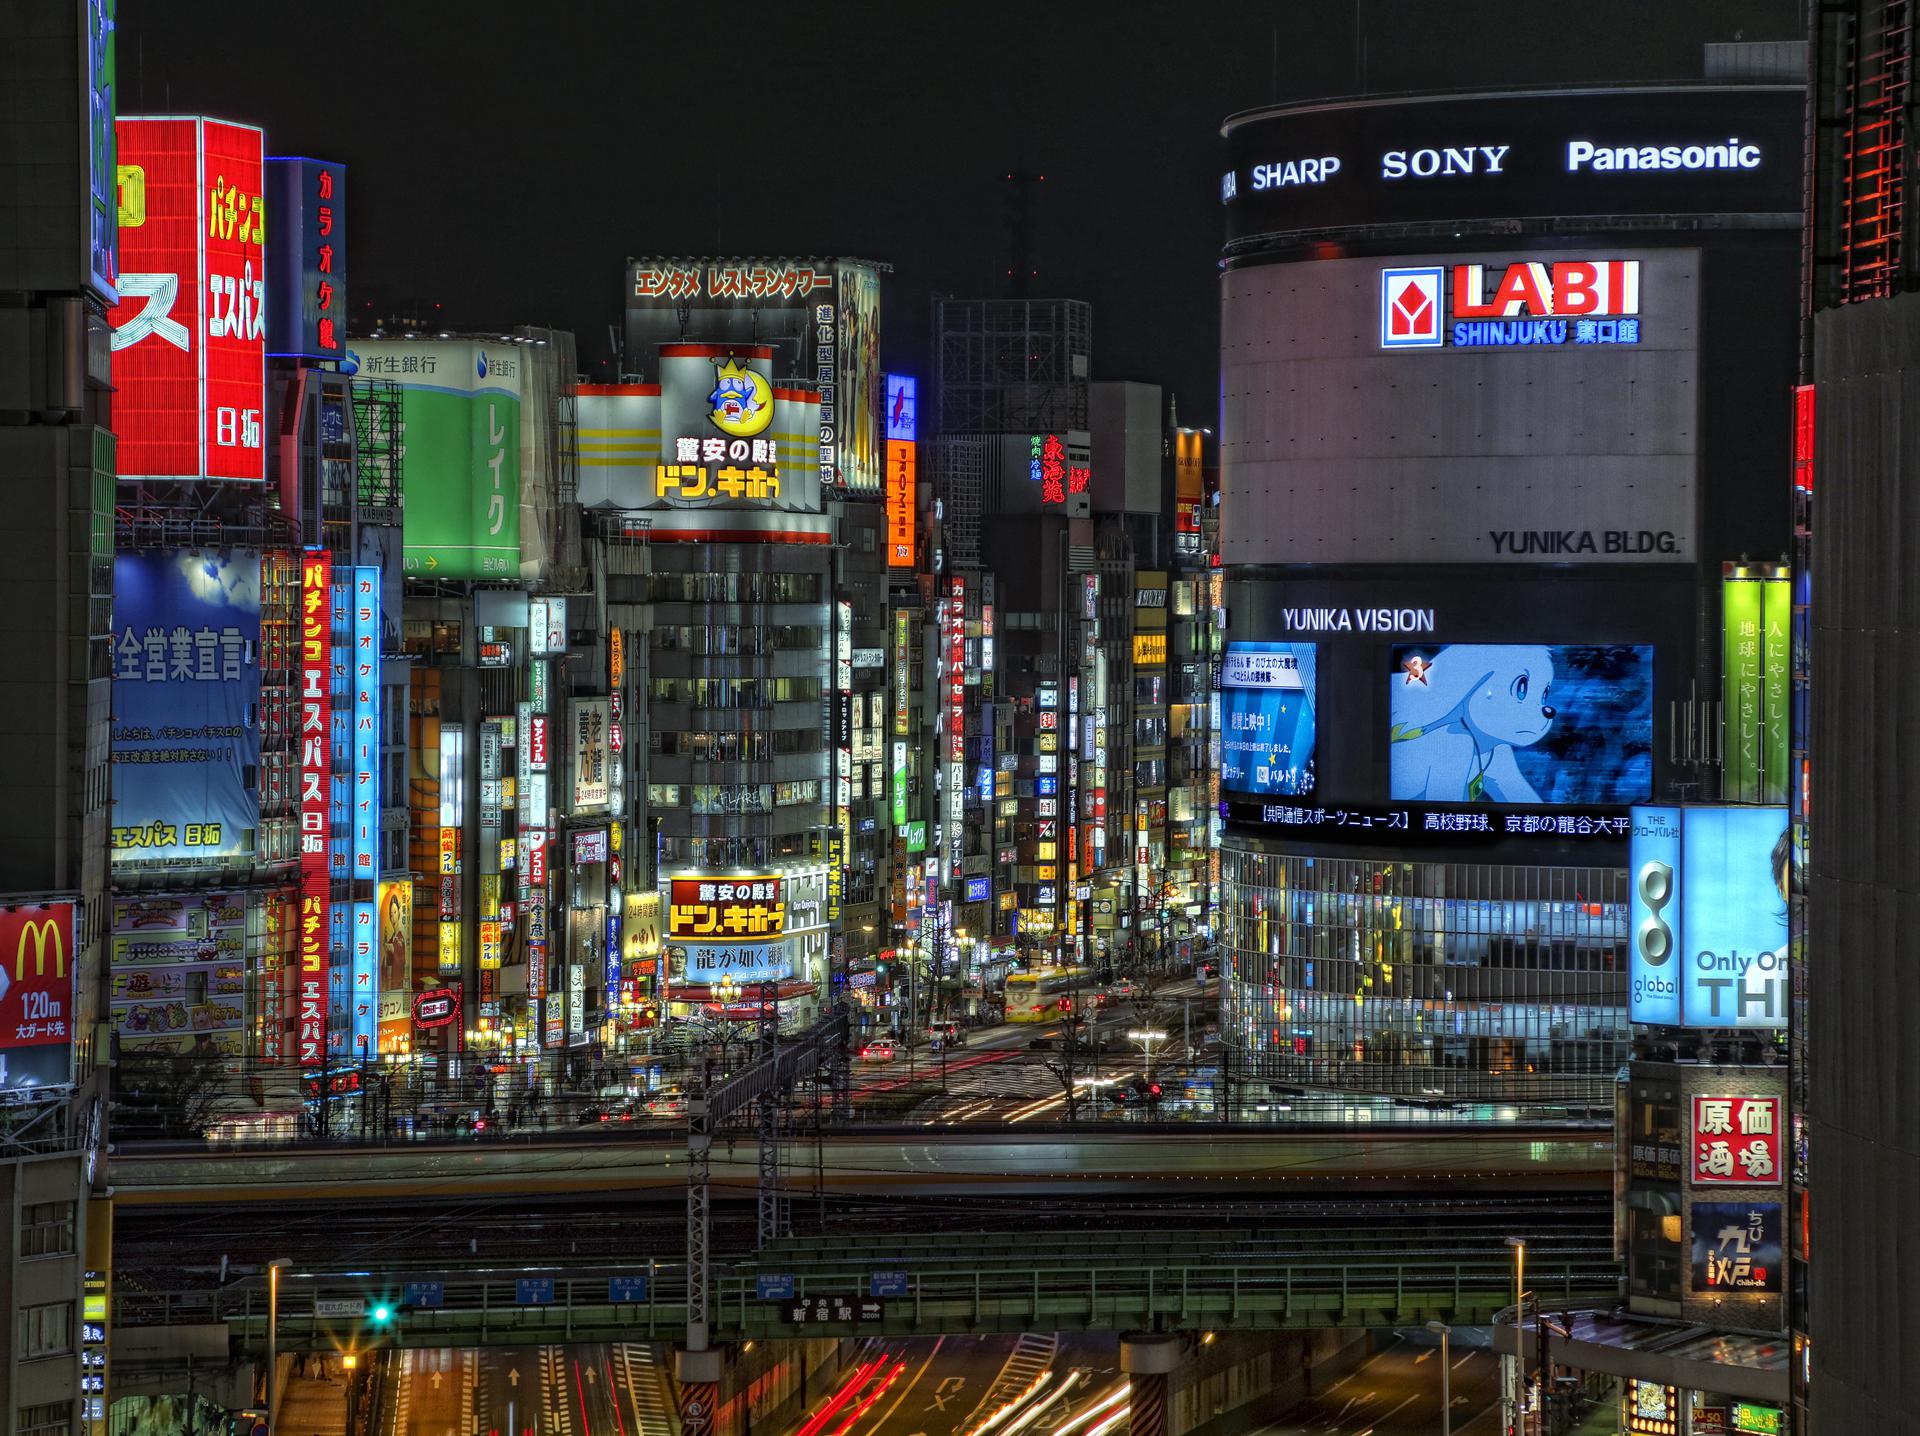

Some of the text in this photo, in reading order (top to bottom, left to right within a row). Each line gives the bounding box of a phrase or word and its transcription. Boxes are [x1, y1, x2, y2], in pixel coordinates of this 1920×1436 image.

[1253, 156, 1341, 190] SHARP
[1383, 145, 1511, 179] SONY
[1569, 137, 1762, 171] Panasonic
[209, 175, 264, 245] パチンコ
[635, 267, 832, 300] エンタメ レストランタワー
[1453, 260, 1641, 319] LABI
[209, 260, 265, 341] エスパス
[1453, 320, 1641, 346] SHINJUKU 東口館
[365, 355, 437, 374] 新生銀行
[216, 406, 261, 448] 日拓
[676, 437, 777, 464] 驚安の殿堂
[487, 403, 505, 536] レイク
[898, 447, 907, 539] PROMISE
[1490, 530, 1682, 554] YUNIKA BLDG.
[1282, 608, 1435, 632] YUNIKA VISION
[112, 626, 243, 682] 全営業宣言
[952, 584, 964, 718] カラオケ パセラ
[1738, 620, 1757, 769] 地球にやさしく。
[1767, 620, 1786, 749] 人にやさしく。
[302, 563, 324, 854] パチンコ エスパス 日拓
[112, 726, 243, 741] したちは、パチンコ・パチスロの
[533, 726, 544, 762] アイフル
[895, 782, 905, 808] レイク
[1262, 805, 1410, 830] 【共同通信スポーツニュース】
[1632, 826, 1680, 839] グローバル社
[1647, 815, 1665, 826] THE
[112, 820, 222, 848] エスパス 日拓
[910, 828, 924, 845] レイク
[532, 851, 544, 876] アコム
[952, 839, 962, 867] ダーツ
[699, 883, 775, 901] 驚安の殿堂
[695, 949, 764, 970] 龍が如く
[1696, 950, 1753, 977] Only
[301, 896, 322, 1061] パチンコ エスパス
[357, 911, 370, 1049] カラオケ館
[1634, 974, 1679, 1004] global
[21, 991, 60, 1020] 120m
[1697, 978, 1789, 1018] TH
[16, 1022, 65, 1040] 大ガード先
[1698, 1100, 1774, 1135] 原価
[1698, 1140, 1774, 1177] 酒場
[1747, 1210, 1765, 1242] ちび
[792, 1308, 852, 1322] 新宿駅
